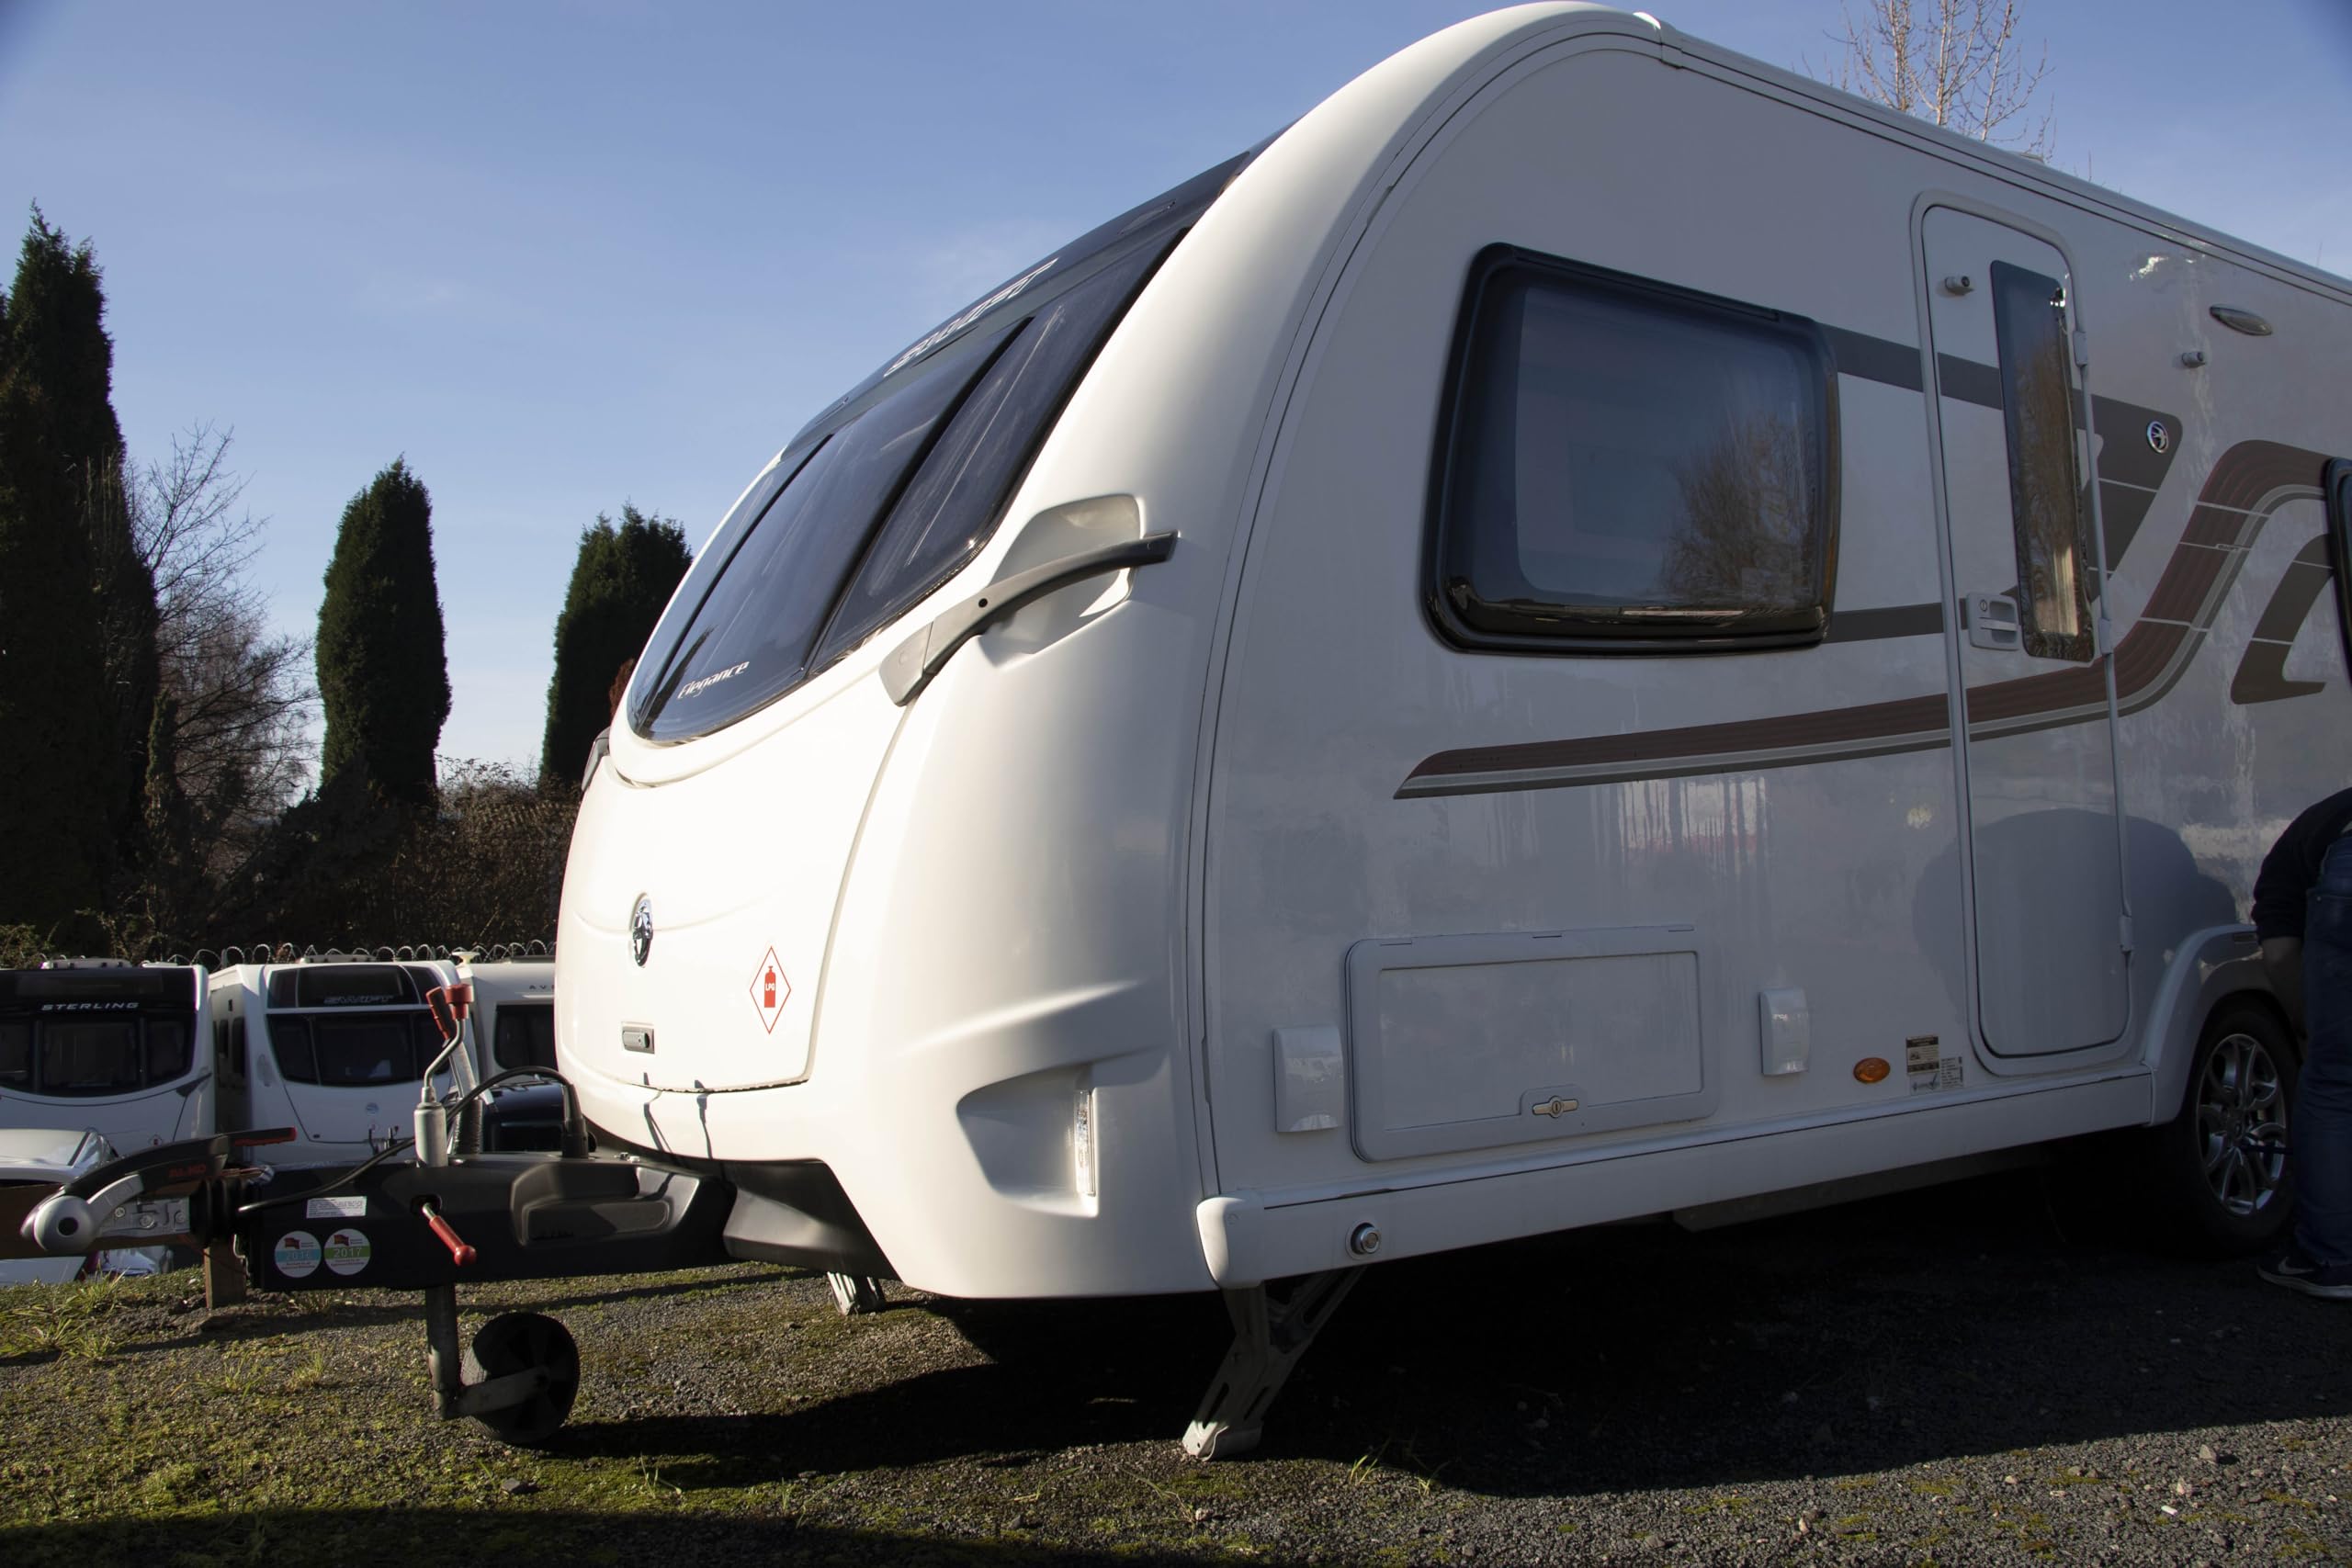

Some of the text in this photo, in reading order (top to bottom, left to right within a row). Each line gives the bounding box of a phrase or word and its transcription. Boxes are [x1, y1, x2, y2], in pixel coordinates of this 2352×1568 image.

[883, 256, 1058, 378] SWIFT
[677, 661, 750, 699] Elegance
[764, 983, 775, 991] LPG
[41, 1002, 139, 1010] STERLING
[334, 1248, 362, 1258] 2017
